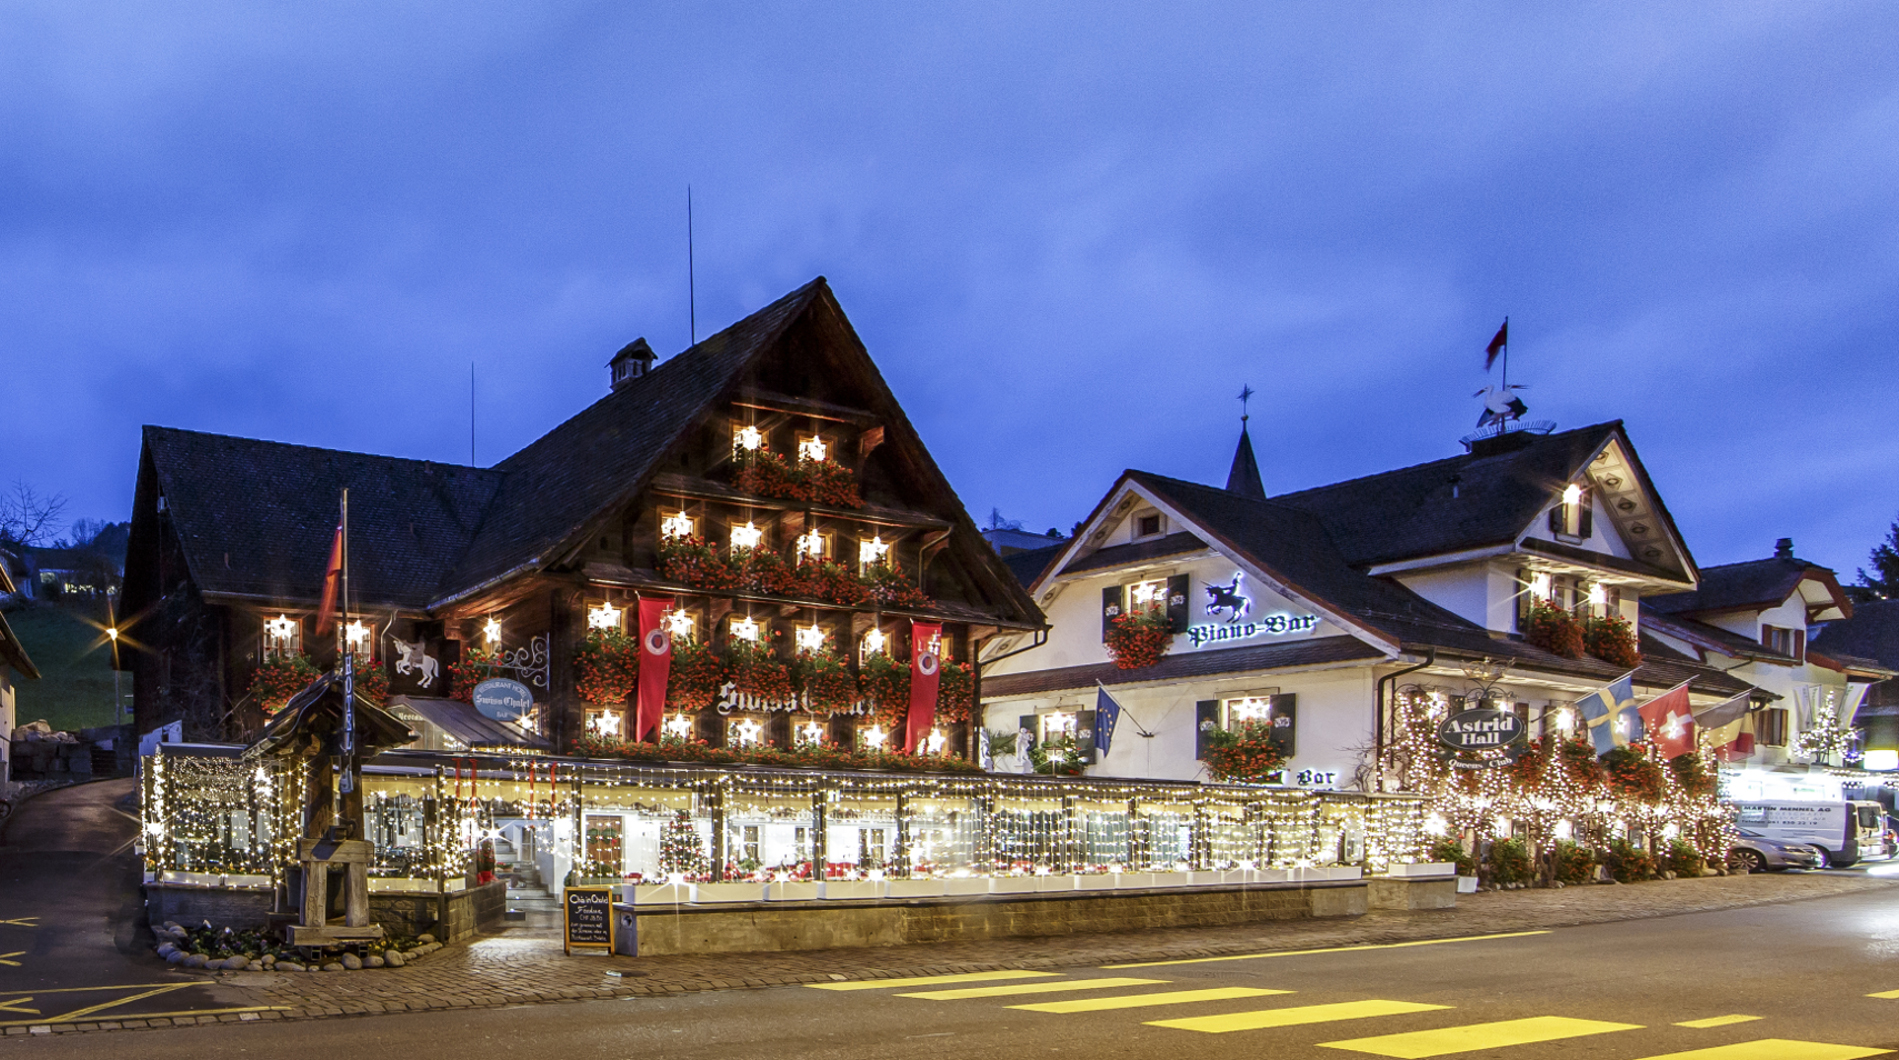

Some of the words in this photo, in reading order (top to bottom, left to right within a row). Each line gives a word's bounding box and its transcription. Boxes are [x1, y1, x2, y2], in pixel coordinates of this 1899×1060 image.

[1188, 615, 1317, 647] Piano-Bar
[479, 682, 511, 693] RESTAURANT
[345, 655, 353, 750] HOTEL
[476, 694, 503, 705] Swiss
[504, 697, 530, 708] Chalet
[1444, 717, 1514, 734] Astrid
[1460, 732, 1500, 745] Hall
[1448, 758, 1483, 769] Queens
[1488, 757, 1513, 768] Club
[1297, 769, 1336, 786] Bar
